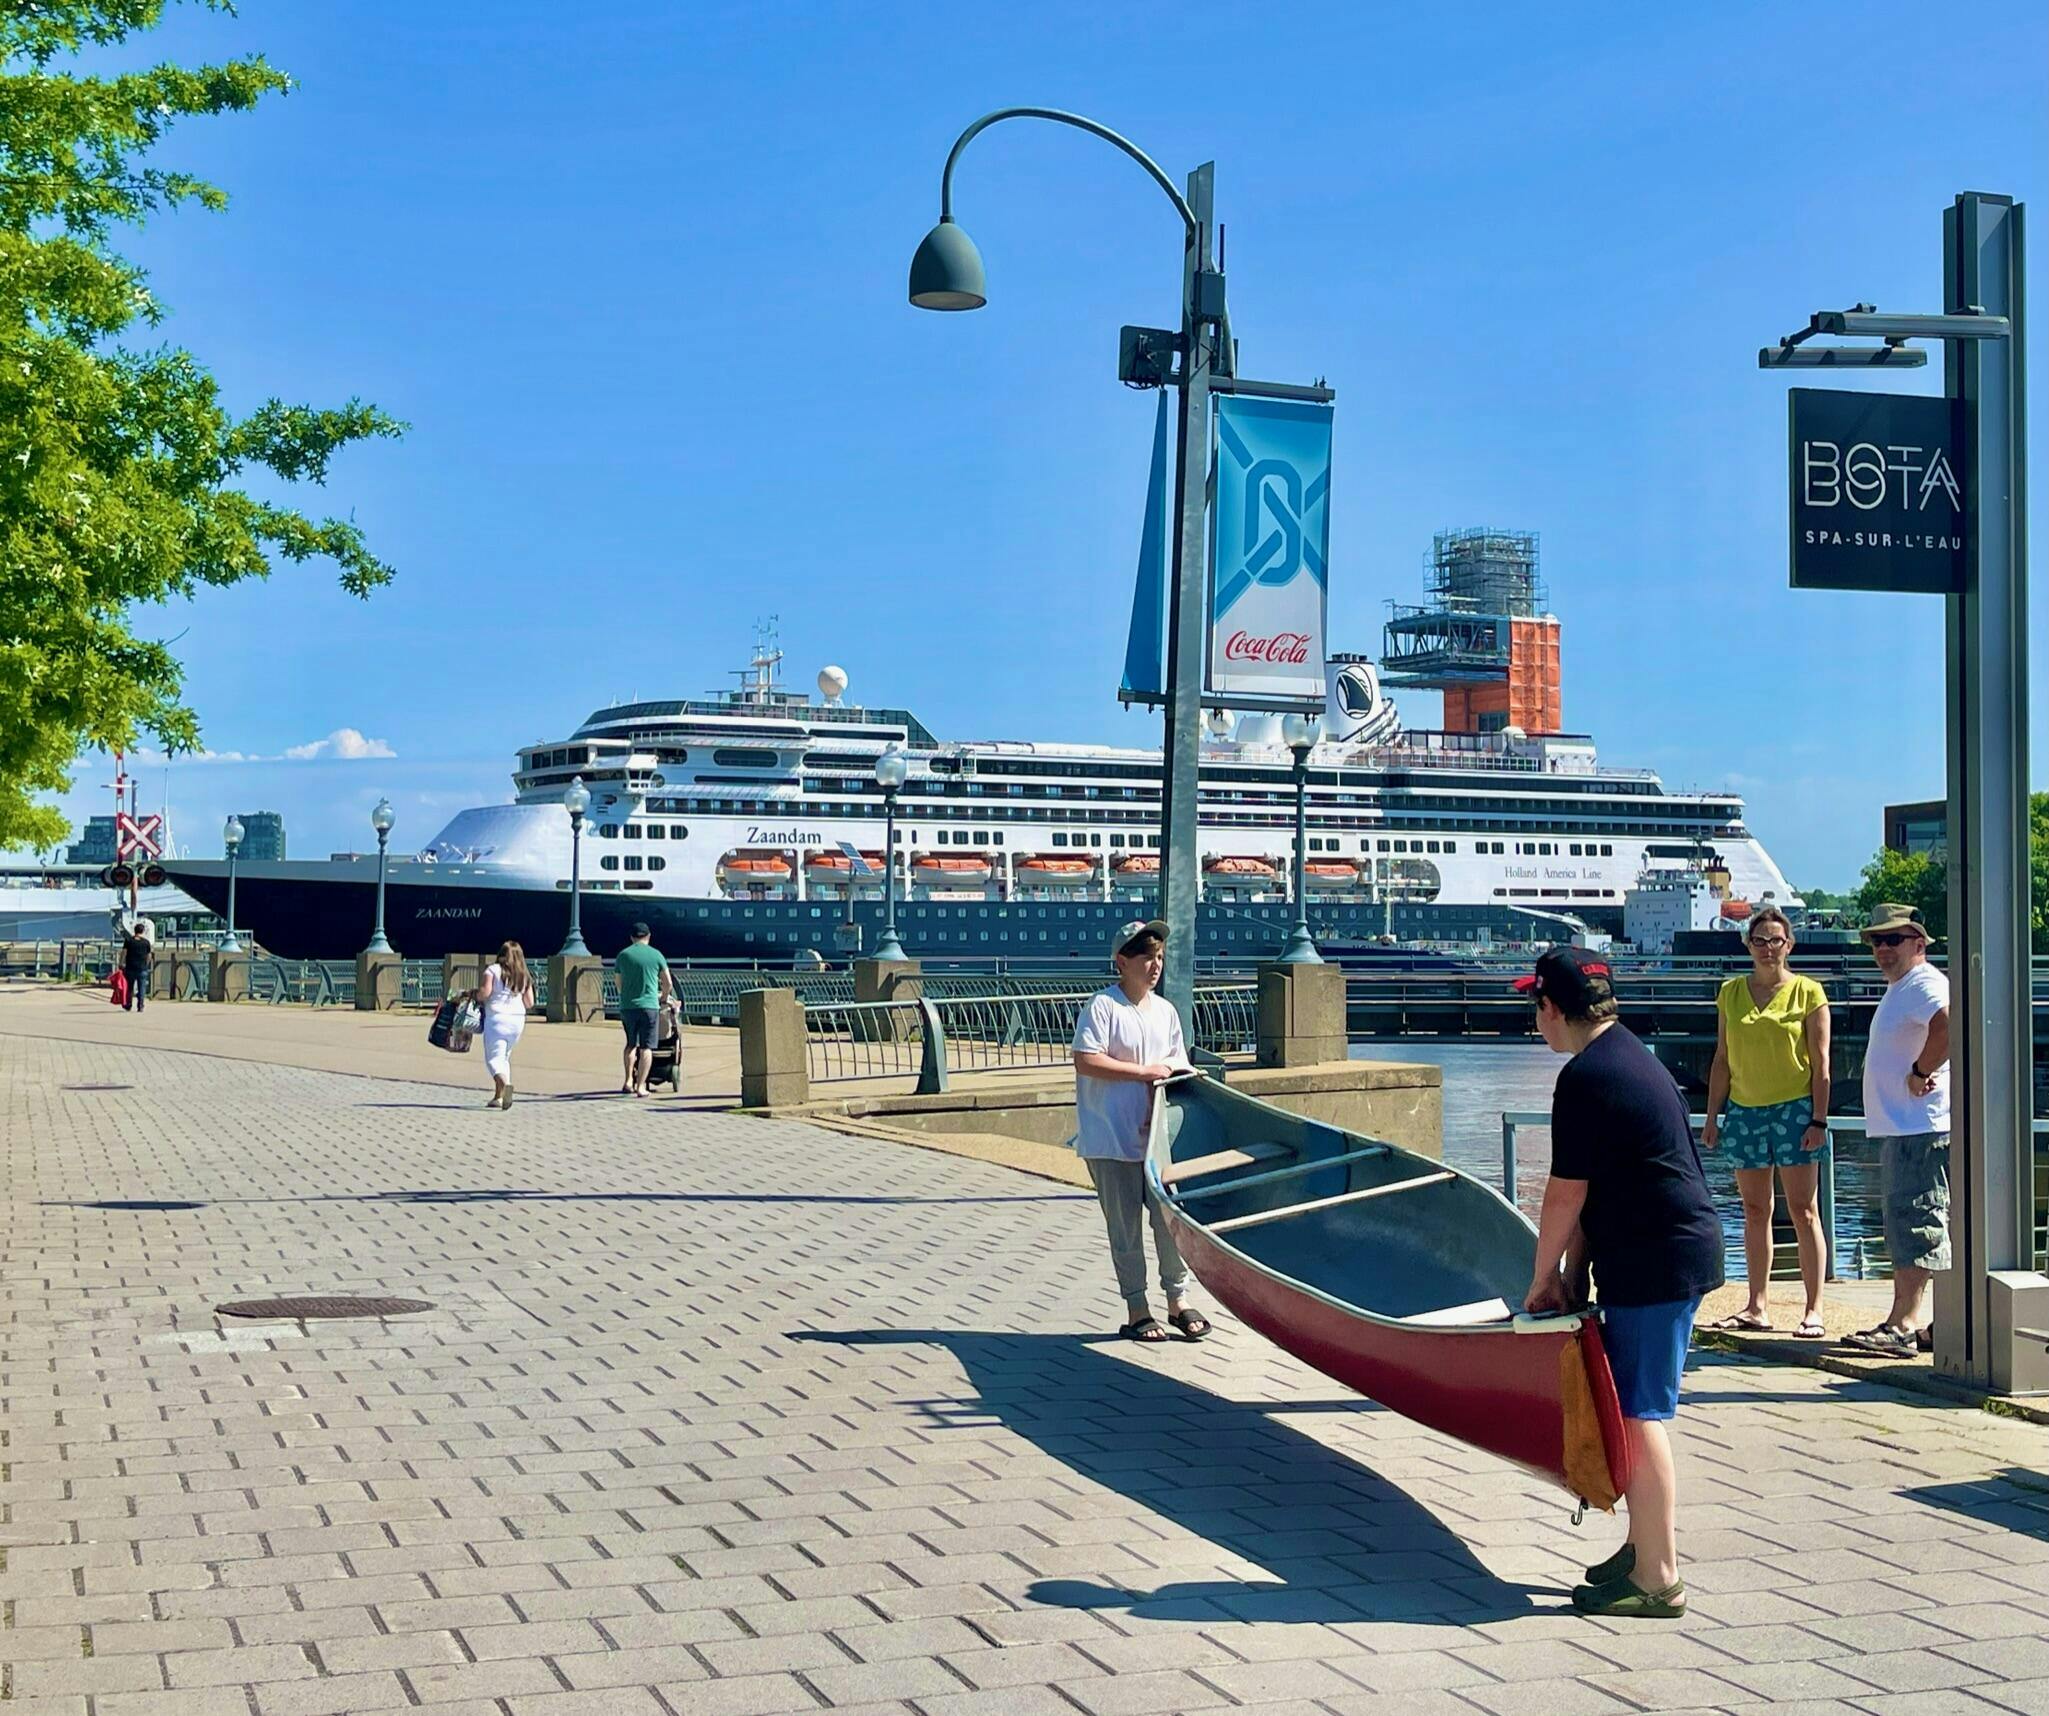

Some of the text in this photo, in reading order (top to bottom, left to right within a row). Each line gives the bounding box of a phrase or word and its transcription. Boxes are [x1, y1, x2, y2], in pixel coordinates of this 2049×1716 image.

[1804, 441, 1961, 512] BOTA
[747, 826, 822, 844] Zaandam
[1505, 866, 1603, 880] Holland America Line
[415, 908, 482, 919] ZAANDAM
